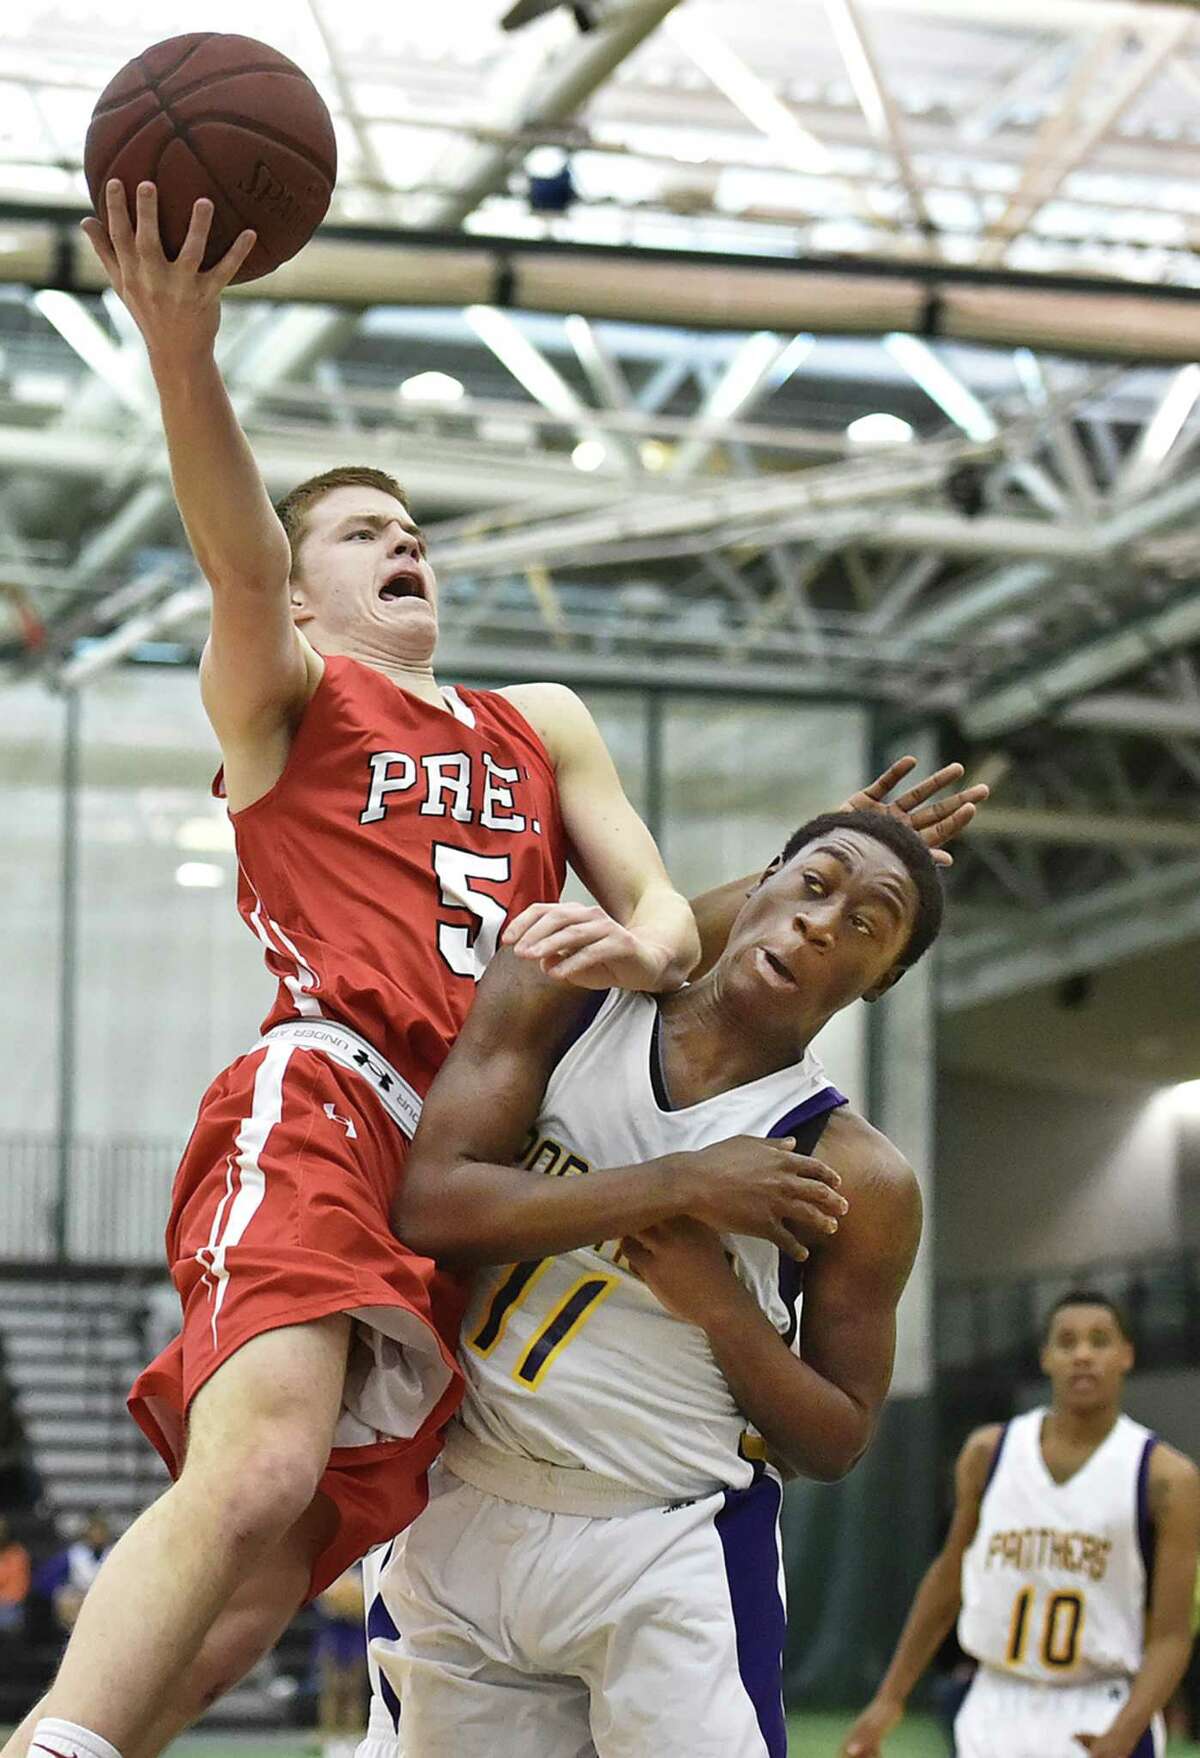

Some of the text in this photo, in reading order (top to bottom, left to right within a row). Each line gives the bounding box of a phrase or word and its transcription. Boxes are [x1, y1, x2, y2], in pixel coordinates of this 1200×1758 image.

[360, 752, 540, 835] PRE
[432, 841, 511, 983] 5
[294, 1029, 349, 1050] UNDER
[465, 1254, 623, 1392] 11
[984, 1528, 1112, 1582] PANTHERS
[1007, 1585, 1085, 1671] 10
